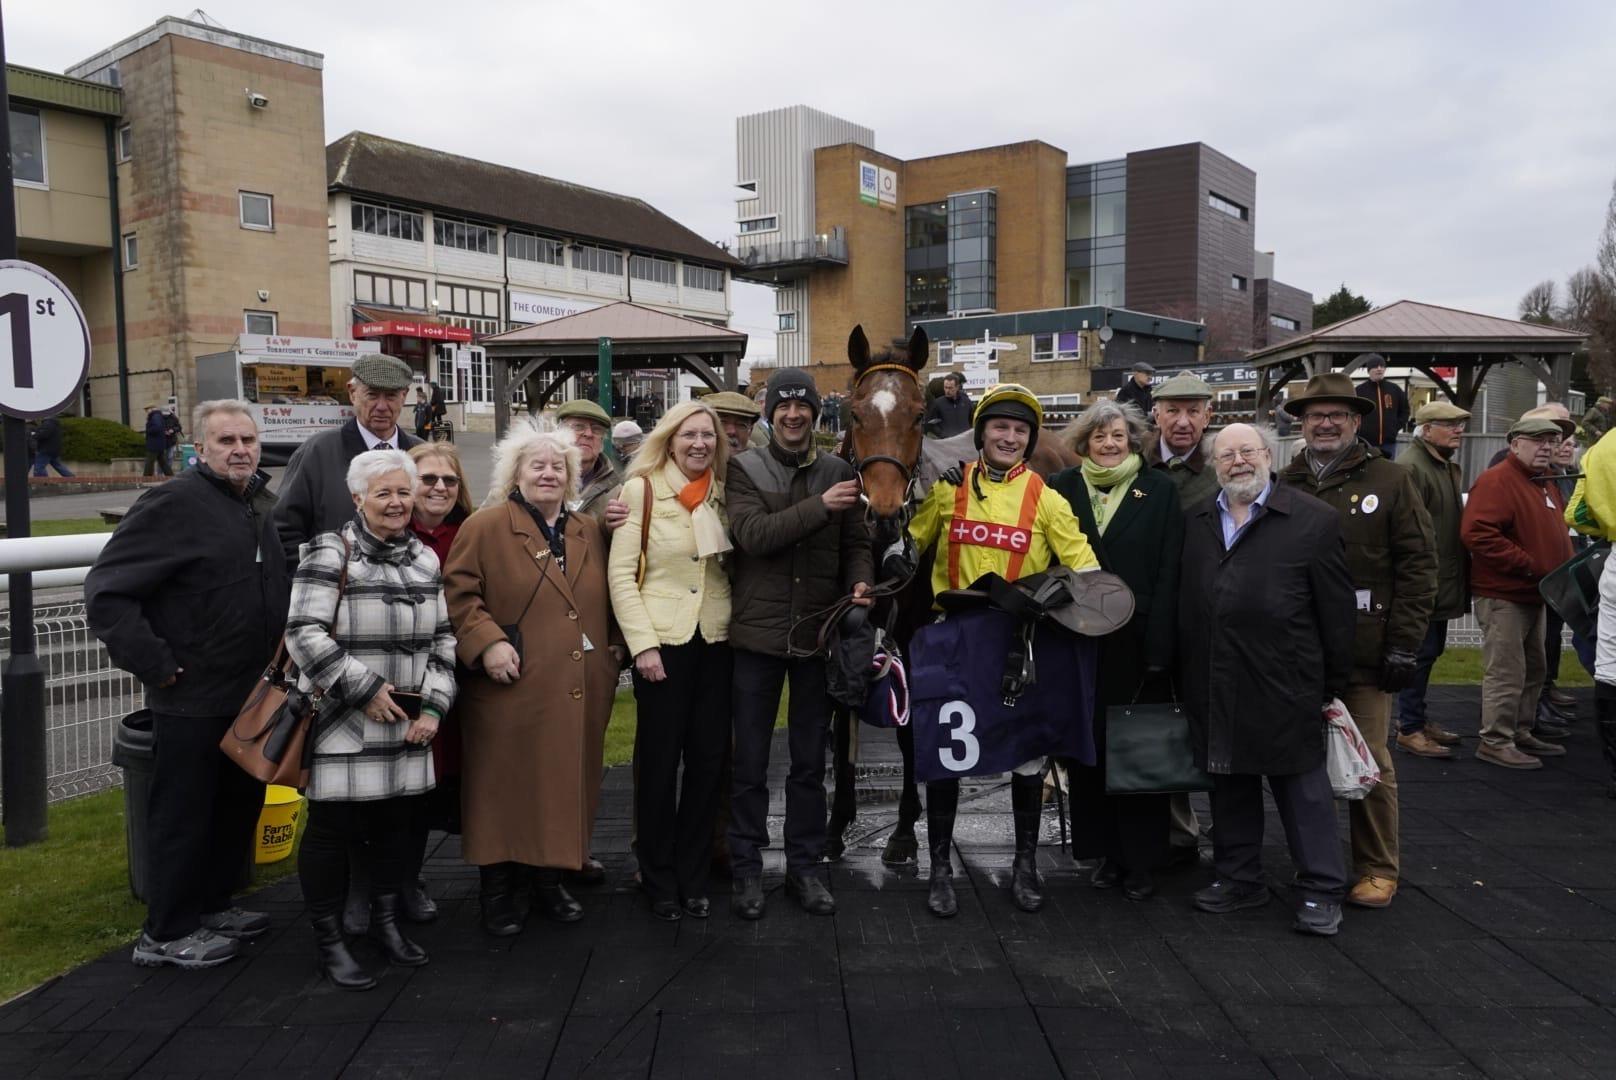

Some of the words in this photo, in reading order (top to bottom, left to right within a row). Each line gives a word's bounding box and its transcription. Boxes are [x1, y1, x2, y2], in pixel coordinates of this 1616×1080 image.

[513, 302, 529, 312] THE
[531, 304, 566, 317] COMEDY
[938, 700, 980, 772] 3
[264, 823, 292, 835] Farm
